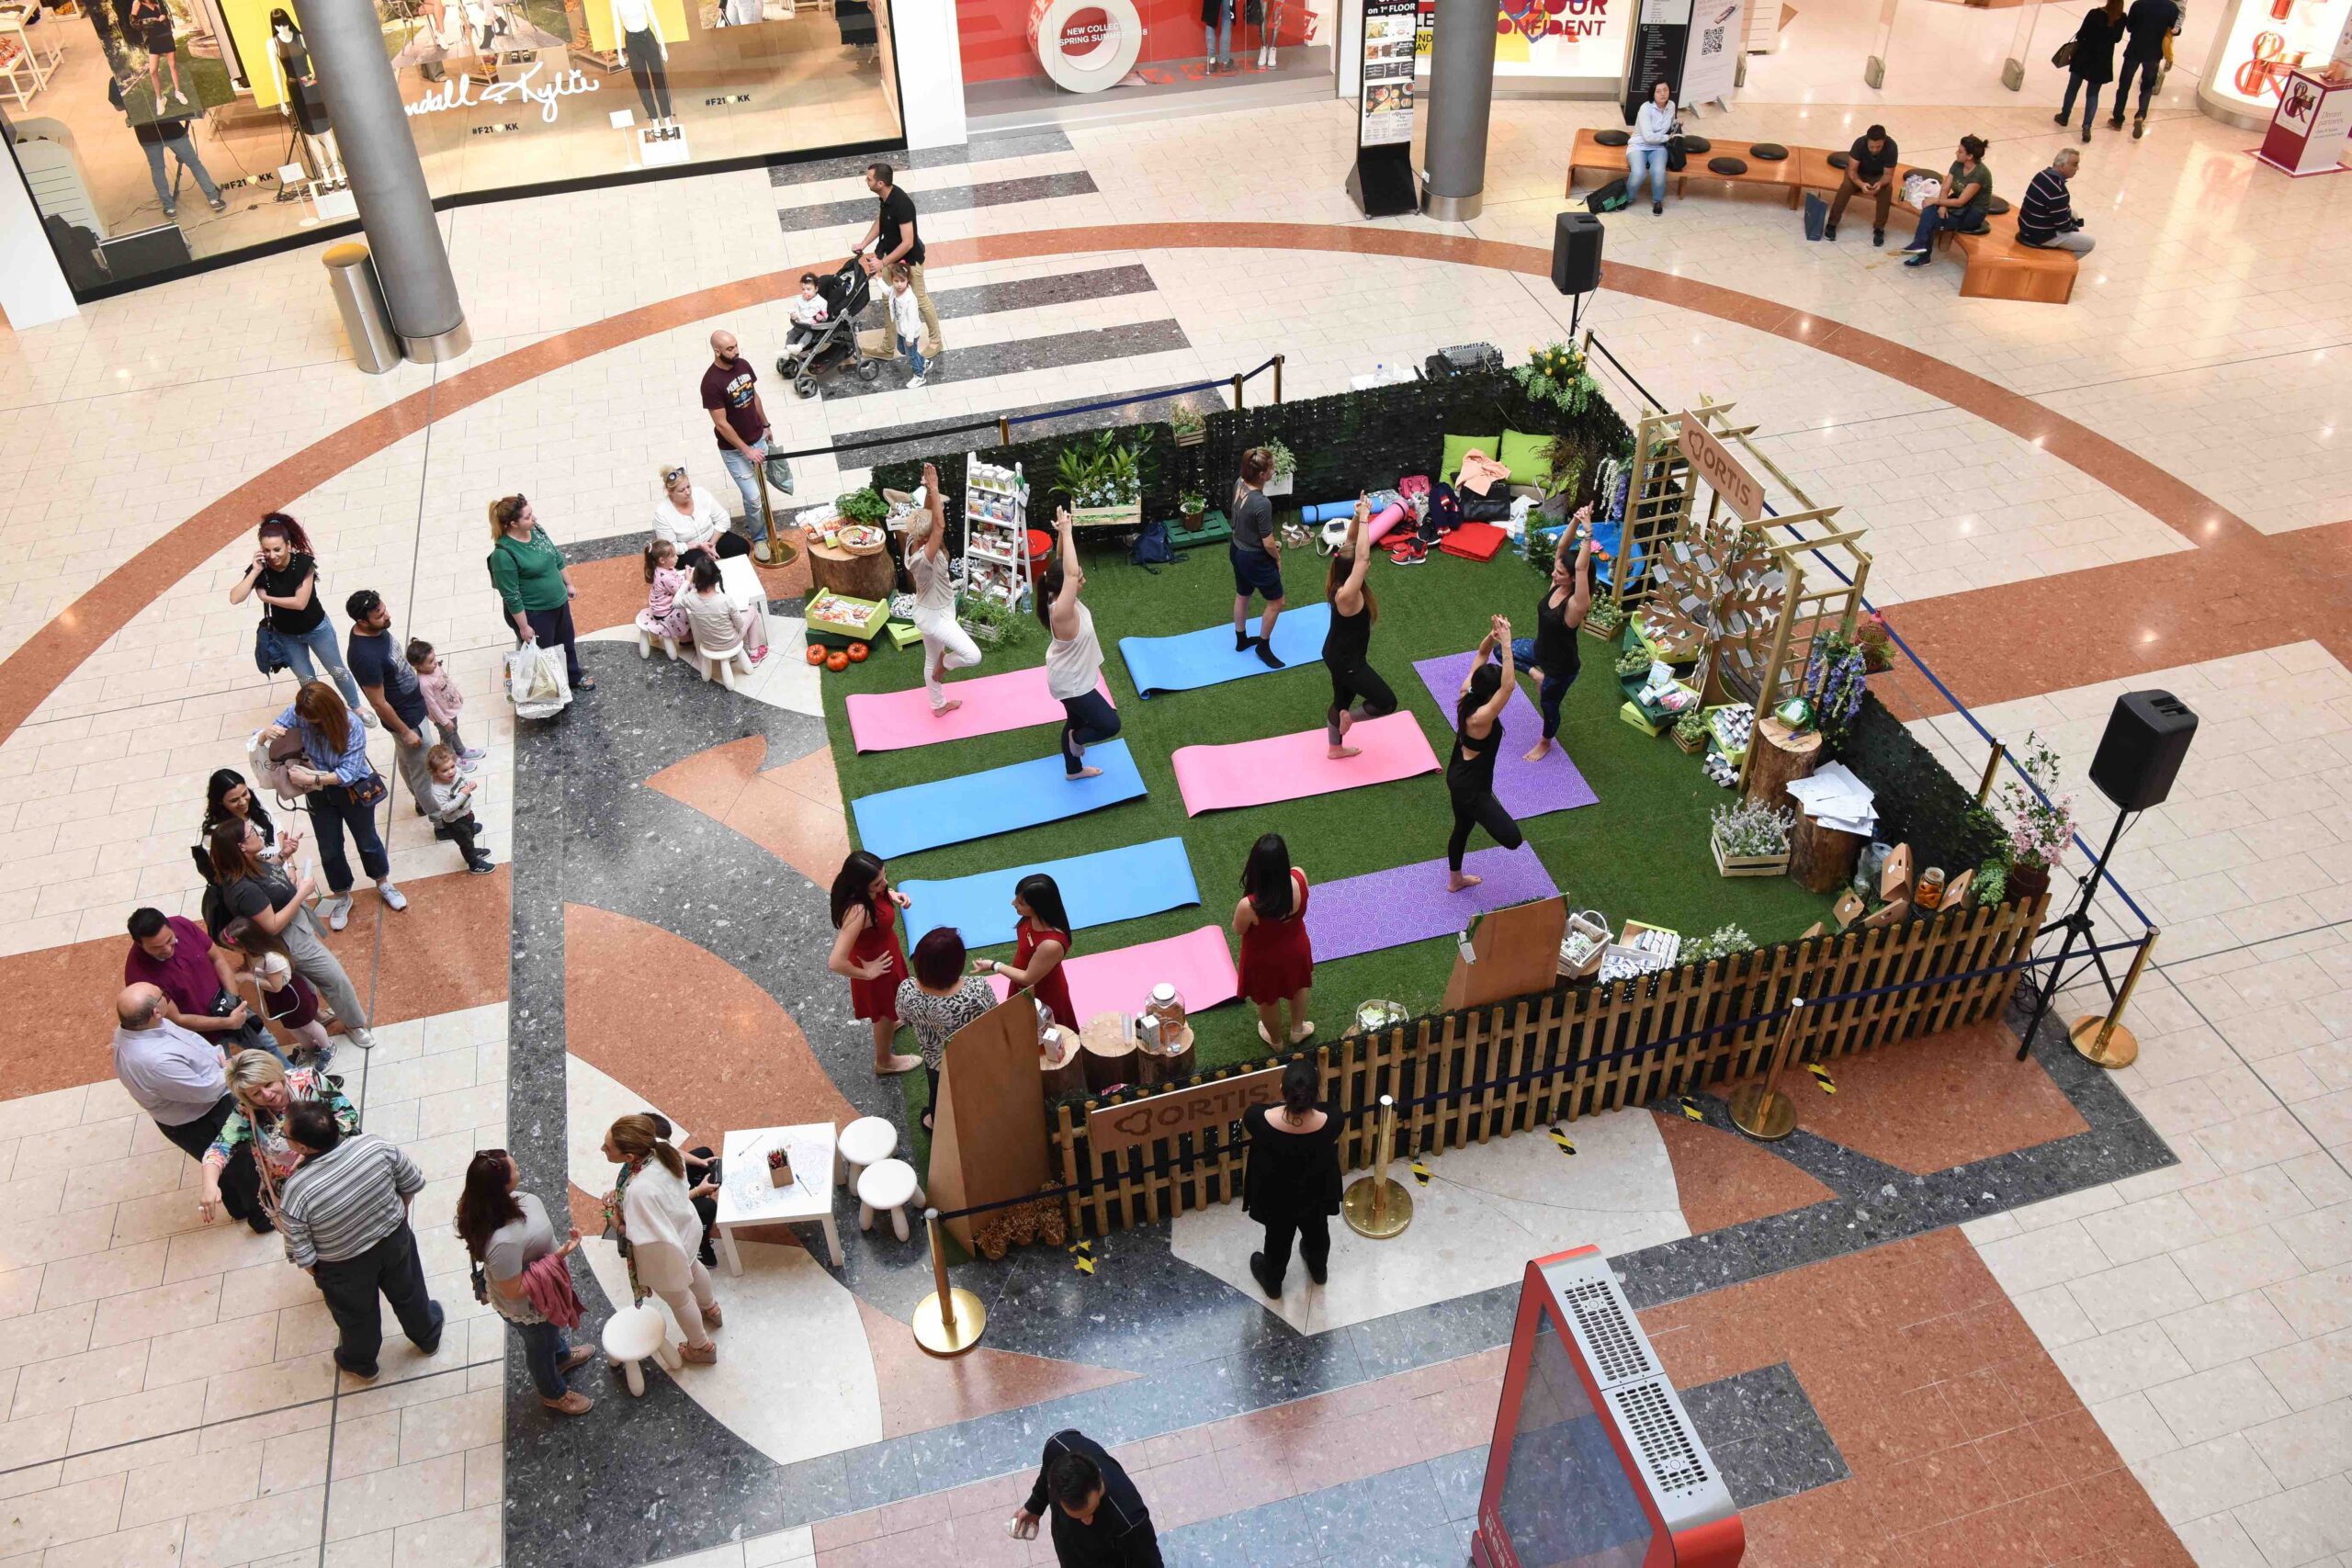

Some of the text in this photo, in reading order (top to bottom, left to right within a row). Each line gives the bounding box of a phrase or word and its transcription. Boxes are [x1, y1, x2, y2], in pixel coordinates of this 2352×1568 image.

[1389, 3, 1416, 12] FLOOR
[1498, 18, 1606, 36] ONFIDENT
[1059, 37, 1090, 46] SPRING
[404, 73, 478, 117] ndall
[520, 62, 599, 122] Kylie
[1485, 1515, 1508, 1568] Rea
